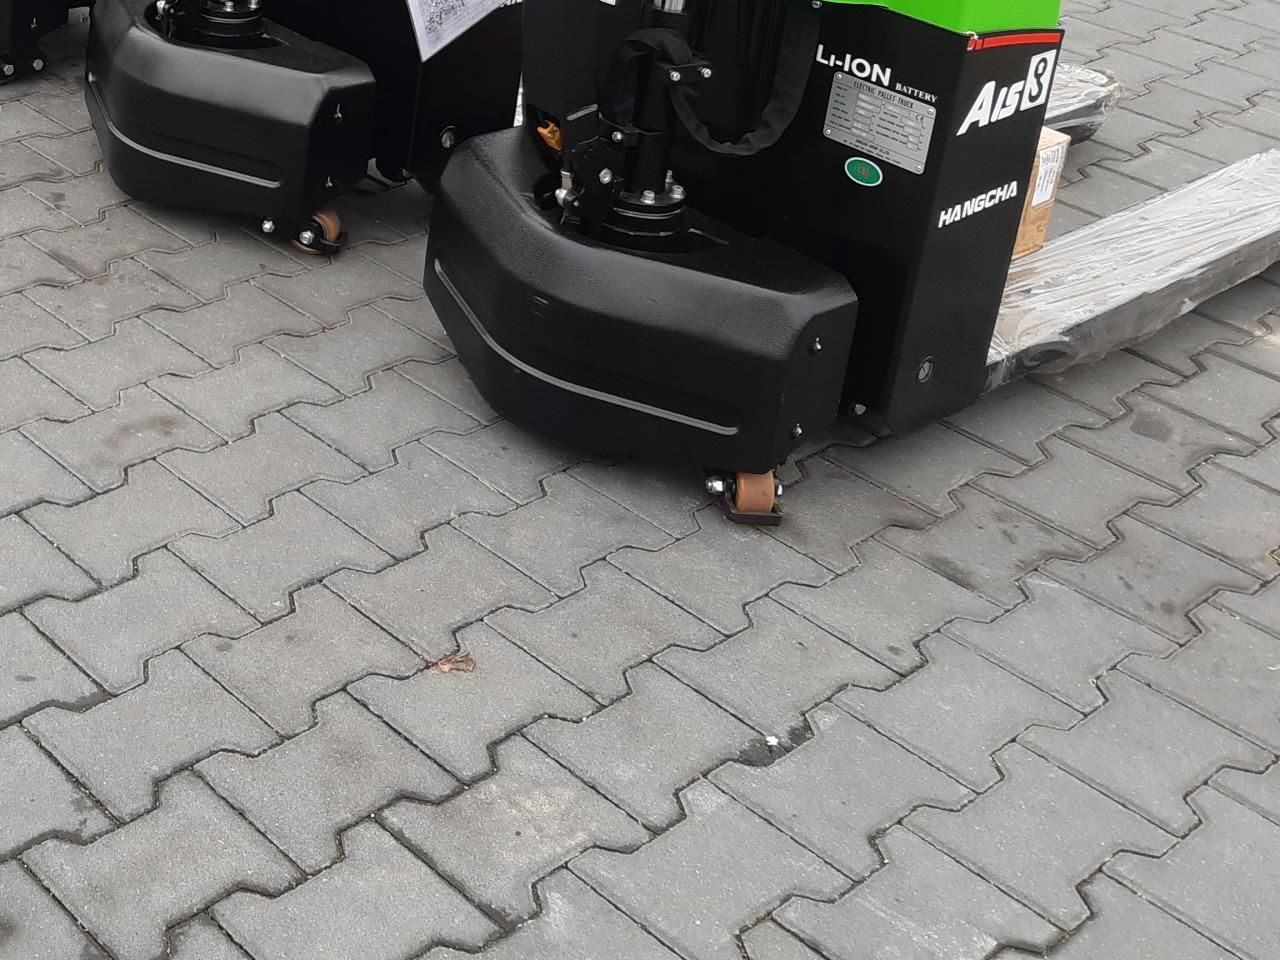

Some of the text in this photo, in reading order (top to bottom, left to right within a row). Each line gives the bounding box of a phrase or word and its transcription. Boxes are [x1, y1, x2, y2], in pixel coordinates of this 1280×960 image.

[853, 80, 914, 109] ELECTRIC PALLET TRUCK
[895, 83, 938, 103] BATTERY
[938, 180, 1017, 228] HANGCHA
